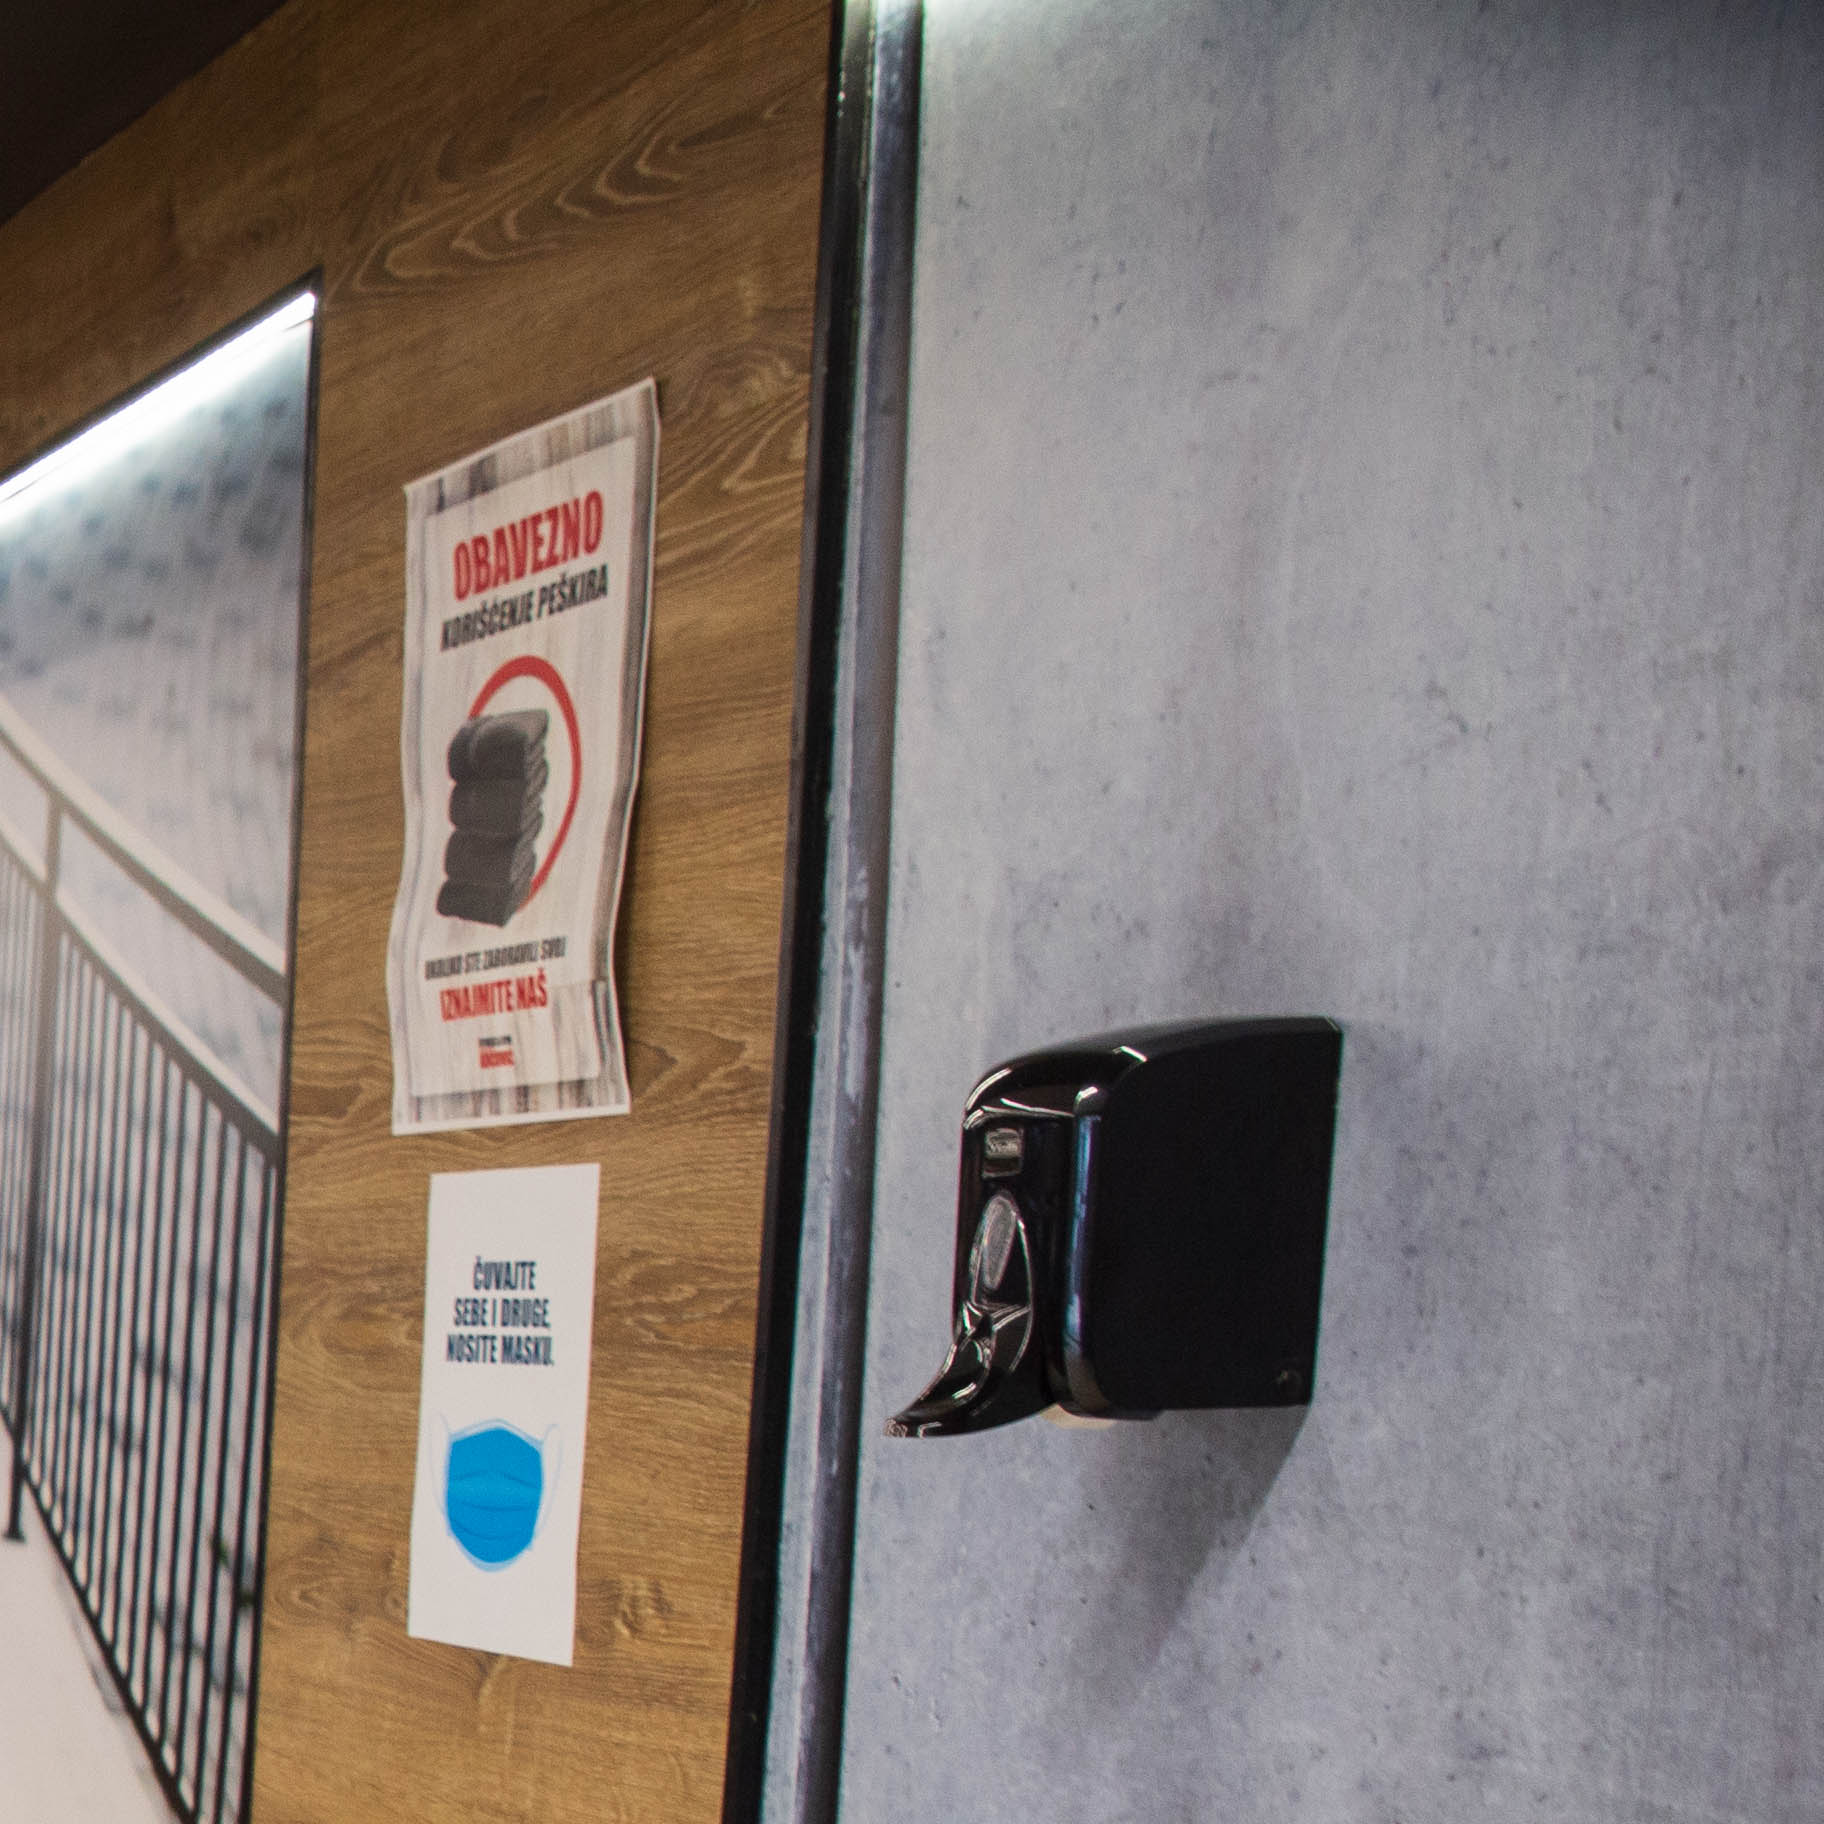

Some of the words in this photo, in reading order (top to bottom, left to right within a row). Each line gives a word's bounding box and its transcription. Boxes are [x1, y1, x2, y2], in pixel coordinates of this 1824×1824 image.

[453, 490, 604, 601] OBAVEZNO
[516, 966, 548, 1008] NAŠ
[454, 1298, 488, 1328] SEBE
[447, 1334, 497, 1364] NOSITE
